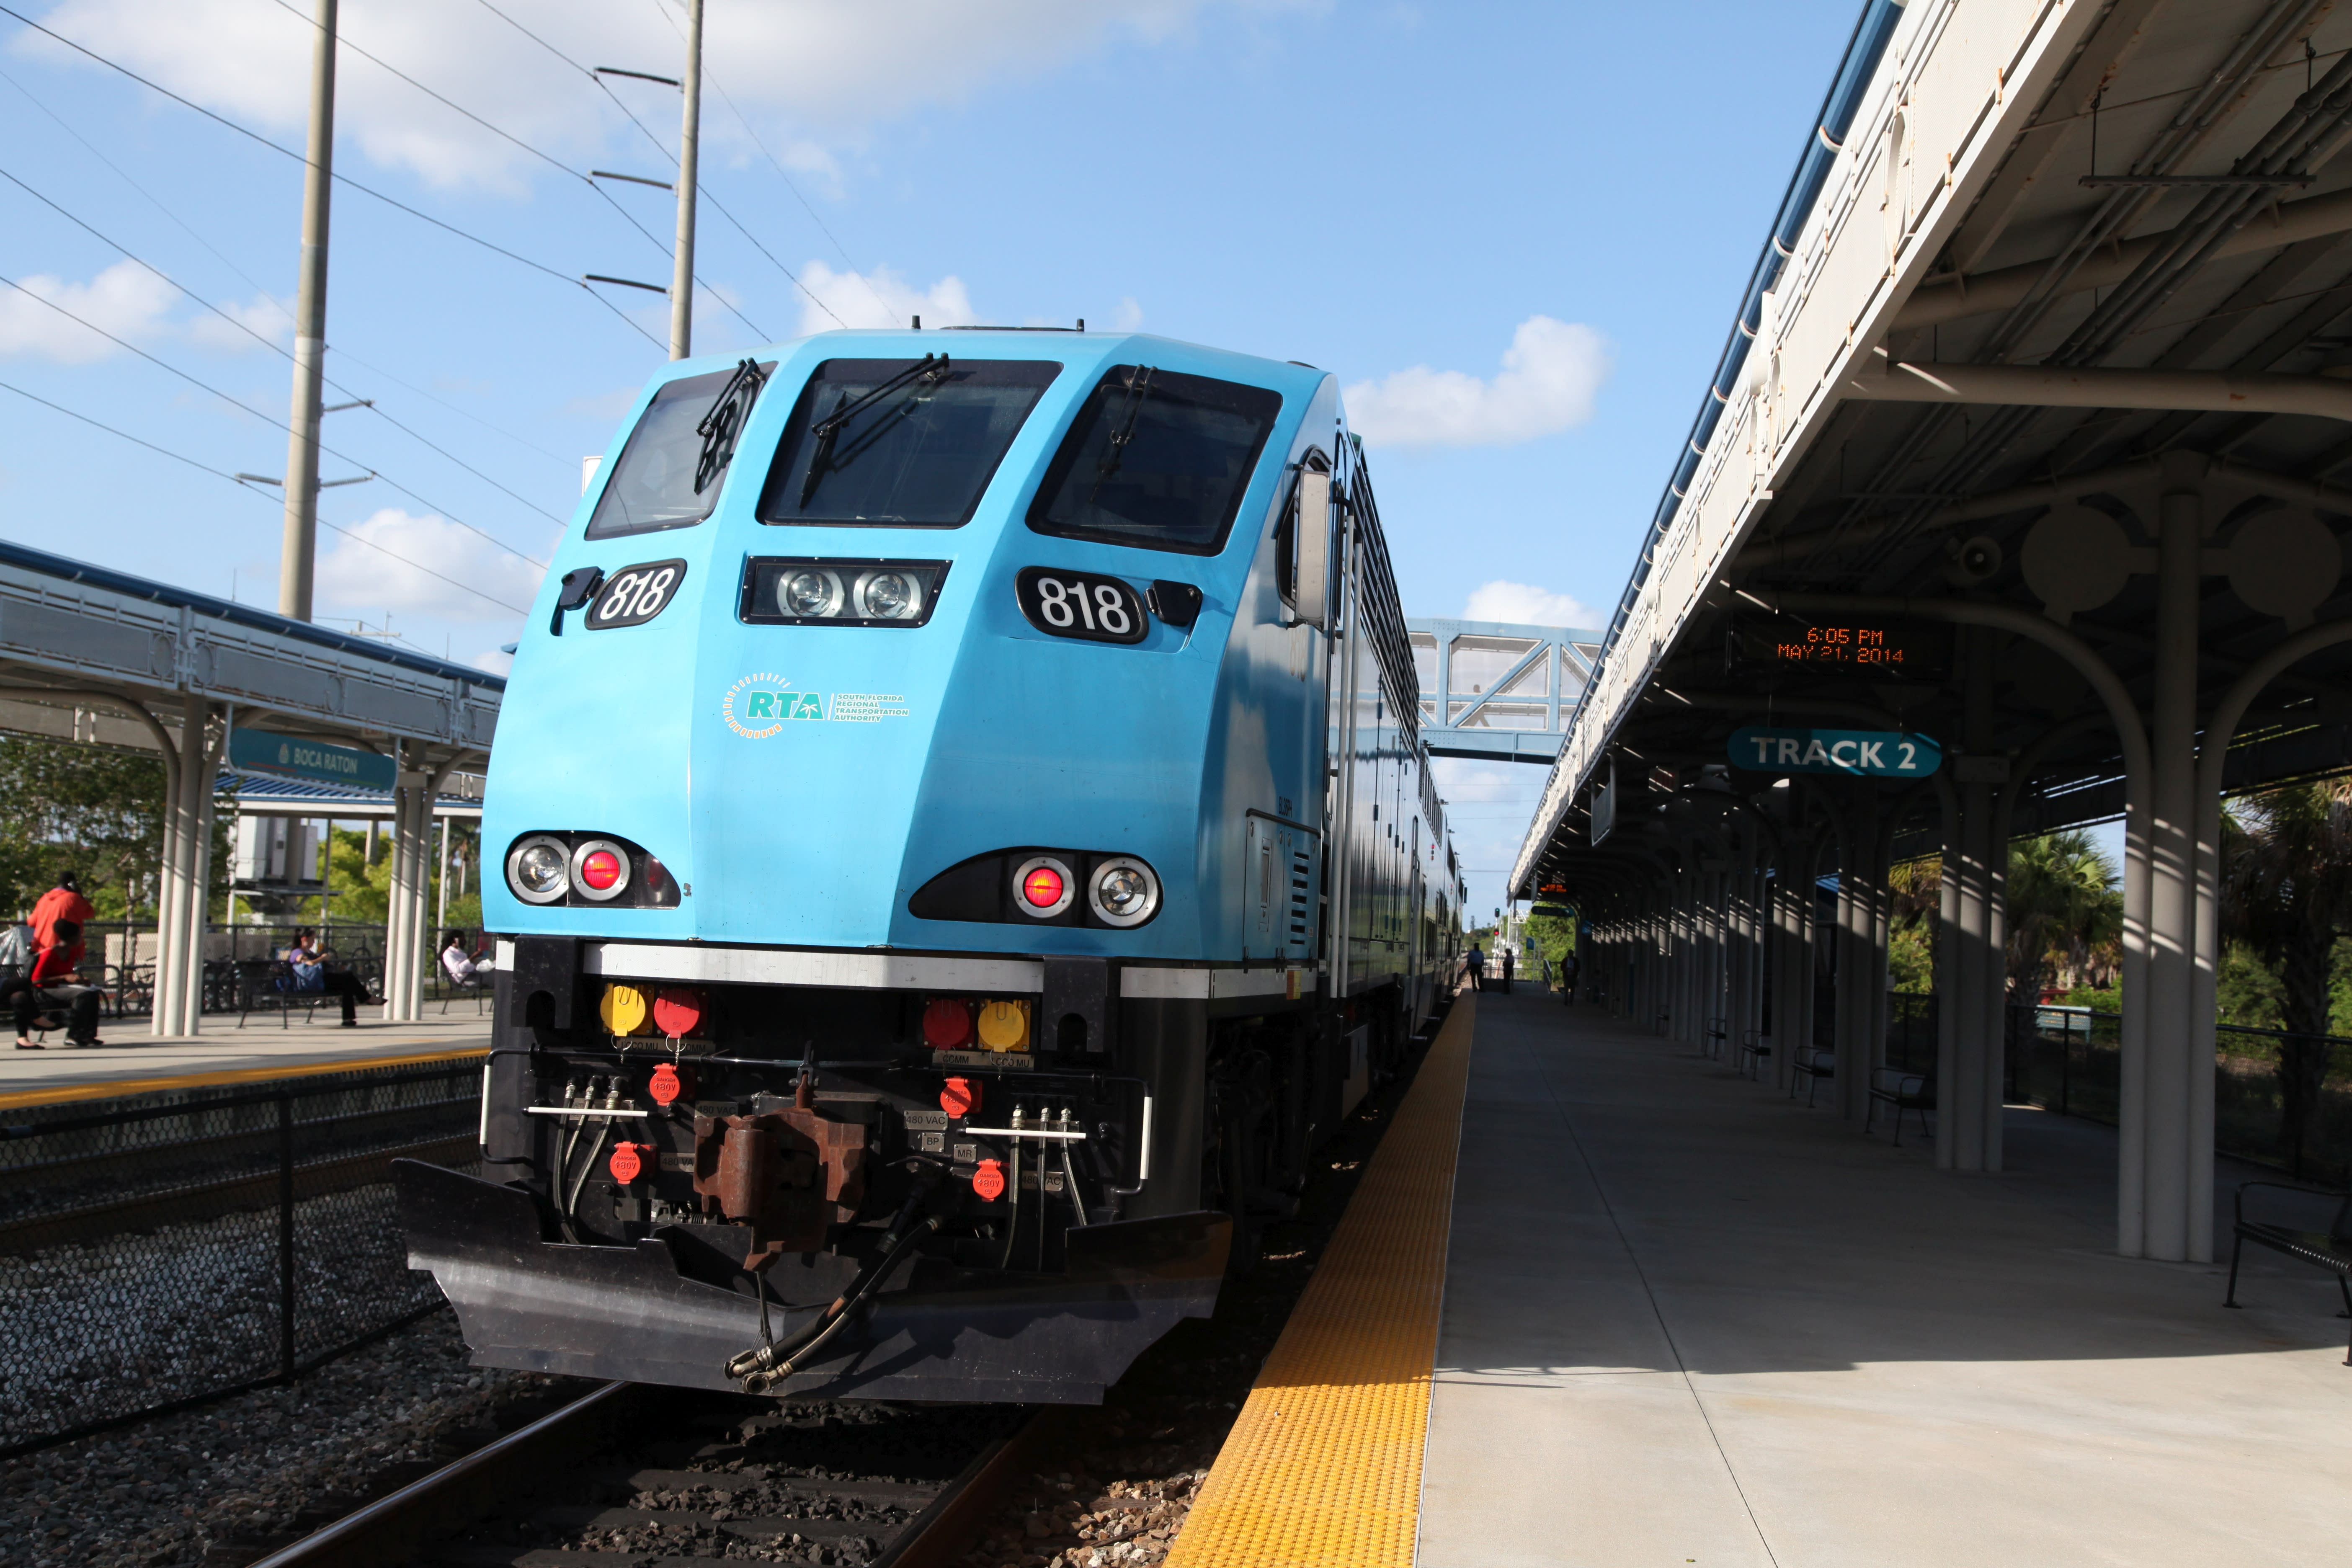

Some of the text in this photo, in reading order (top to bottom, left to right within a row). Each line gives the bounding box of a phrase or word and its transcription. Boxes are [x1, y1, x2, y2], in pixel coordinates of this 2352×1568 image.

[600, 568, 675, 620] 818
[1037, 577, 1130, 634] 818
[1807, 627, 1883, 645] 6:05 PM
[1778, 644, 1903, 664] MAY 21, 2014
[746, 691, 825, 720] RTA
[294, 747, 358, 774] BOCA RATON
[1750, 737, 1916, 770] TRACK 2
[943, 1055, 969, 1064] COMM
[1016, 1059, 1029, 1068] MU
[654, 1082, 676, 1091] 480V
[697, 1105, 737, 1115] 480 VAC
[927, 1137, 939, 1145] BP
[662, 1158, 694, 1166] 480 VA
[977, 1179, 1000, 1187] 480V
[1022, 1176, 1061, 1185] 480 AC
